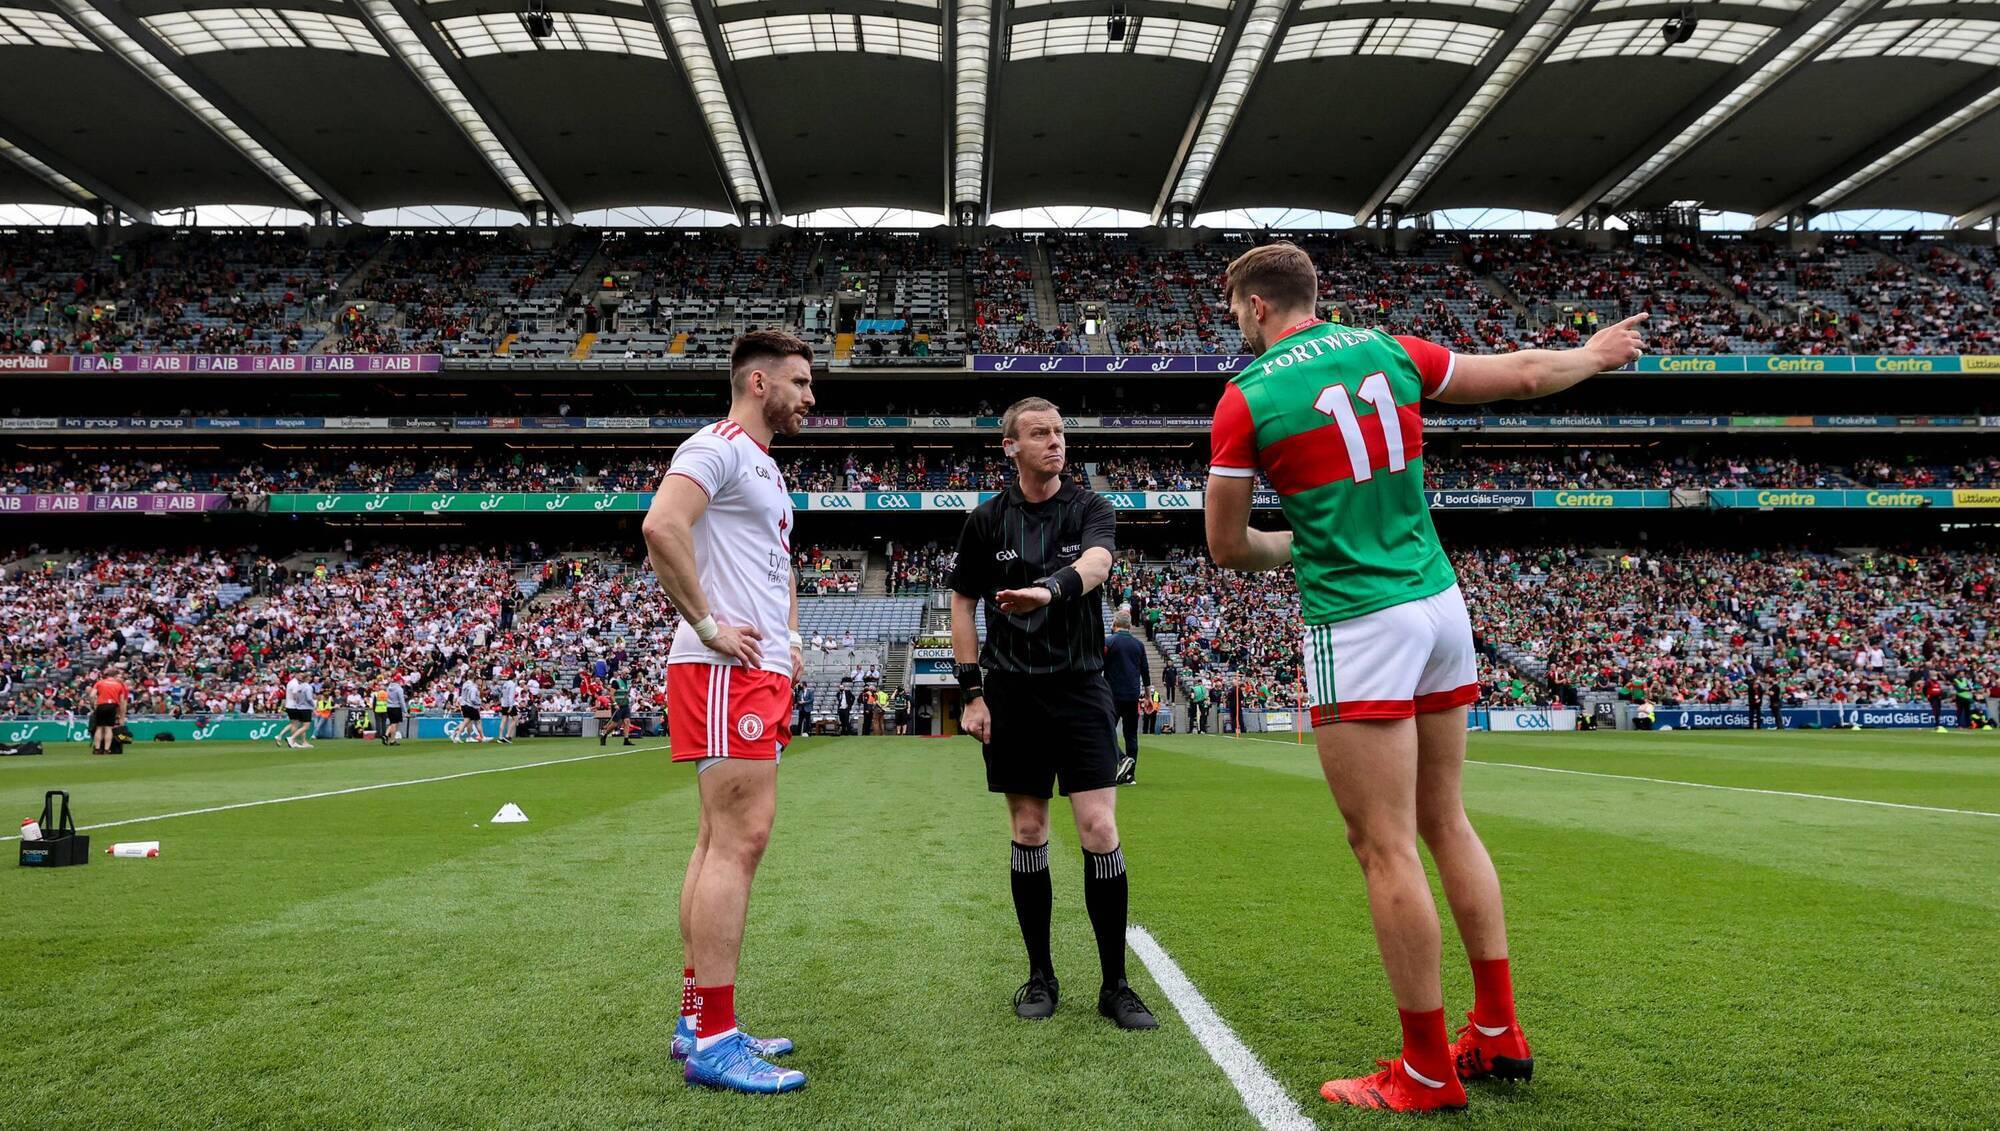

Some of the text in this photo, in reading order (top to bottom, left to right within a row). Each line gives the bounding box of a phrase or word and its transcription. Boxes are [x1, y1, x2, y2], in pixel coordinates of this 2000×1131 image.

[1262, 329, 1381, 376] PORTWEST
[154, 358, 181, 370] AIB
[212, 358, 239, 370] AIB
[269, 358, 295, 370] AIB
[328, 358, 354, 370] AIB
[385, 358, 411, 370] AIB
[995, 357, 1017, 371] eir
[1040, 357, 1062, 371] eir
[1107, 357, 1128, 371] eir
[1152, 357, 1173, 371] eir
[1218, 357, 1239, 371] eir
[1660, 357, 1716, 371] Centra
[1768, 357, 1824, 371] Centra
[1876, 357, 1932, 371] Centra
[66, 418, 118, 429] kn group
[131, 418, 183, 429] kn group
[825, 418, 838, 426] AIB
[1313, 370, 1407, 485] 11
[1423, 416, 1477, 427] BoyleSports
[1500, 417, 1527, 426] GAA.ie
[52, 497, 80, 510] AIB
[111, 497, 138, 510] AIB
[169, 497, 195, 510] AIB
[317, 495, 341, 510] eir
[366, 495, 389, 510] eir
[432, 494, 455, 510] eir
[481, 494, 504, 510] eir
[546, 494, 569, 510] eir
[595, 494, 618, 510] eir
[821, 494, 852, 508] GAA
[877, 494, 910, 508] GAA
[933, 494, 964, 508] GAA
[1158, 494, 1189, 508] GAA
[1446, 491, 1526, 506] Bord Gáis Energy
[1556, 492, 1613, 506] Centra
[1758, 491, 1815, 506] Centra
[1867, 491, 1924, 506] Centra
[1599, 703, 1611, 713] 33
[1694, 714, 1721, 725] Bord
[1723, 713, 1750, 725] Gáis
[1864, 713, 1892, 724] Bord
[1893, 712, 1919, 724] Gáis
[11, 724, 39, 741] eir
[193, 723, 219, 740] eir
[250, 722, 276, 739] eir
